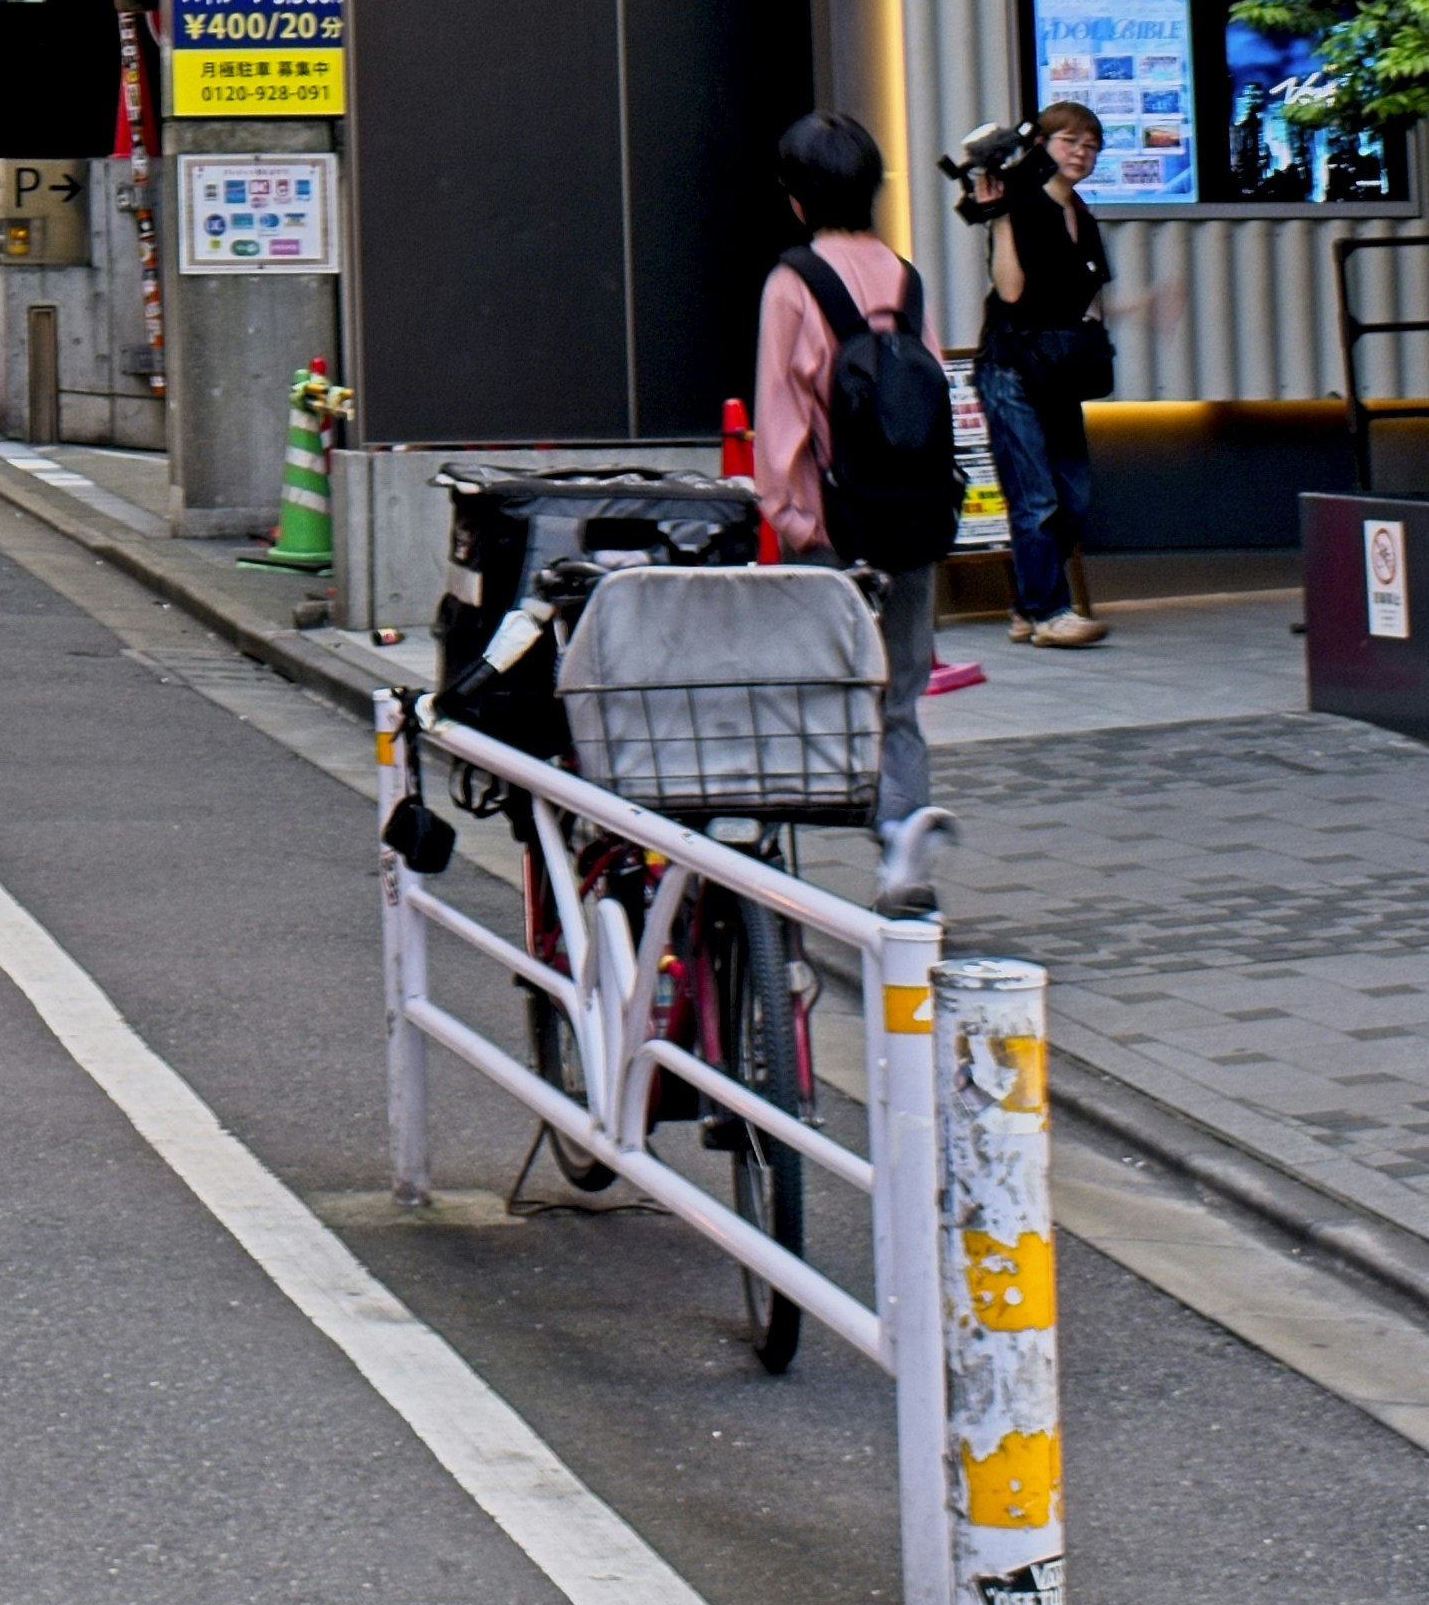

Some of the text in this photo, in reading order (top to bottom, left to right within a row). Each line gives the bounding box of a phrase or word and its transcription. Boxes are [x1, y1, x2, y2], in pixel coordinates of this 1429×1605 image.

[200, 60, 330, 79] 月極駐車 募集中
[201, 84, 331, 103] 0120-928-091
[14, 166, 41, 208] P
